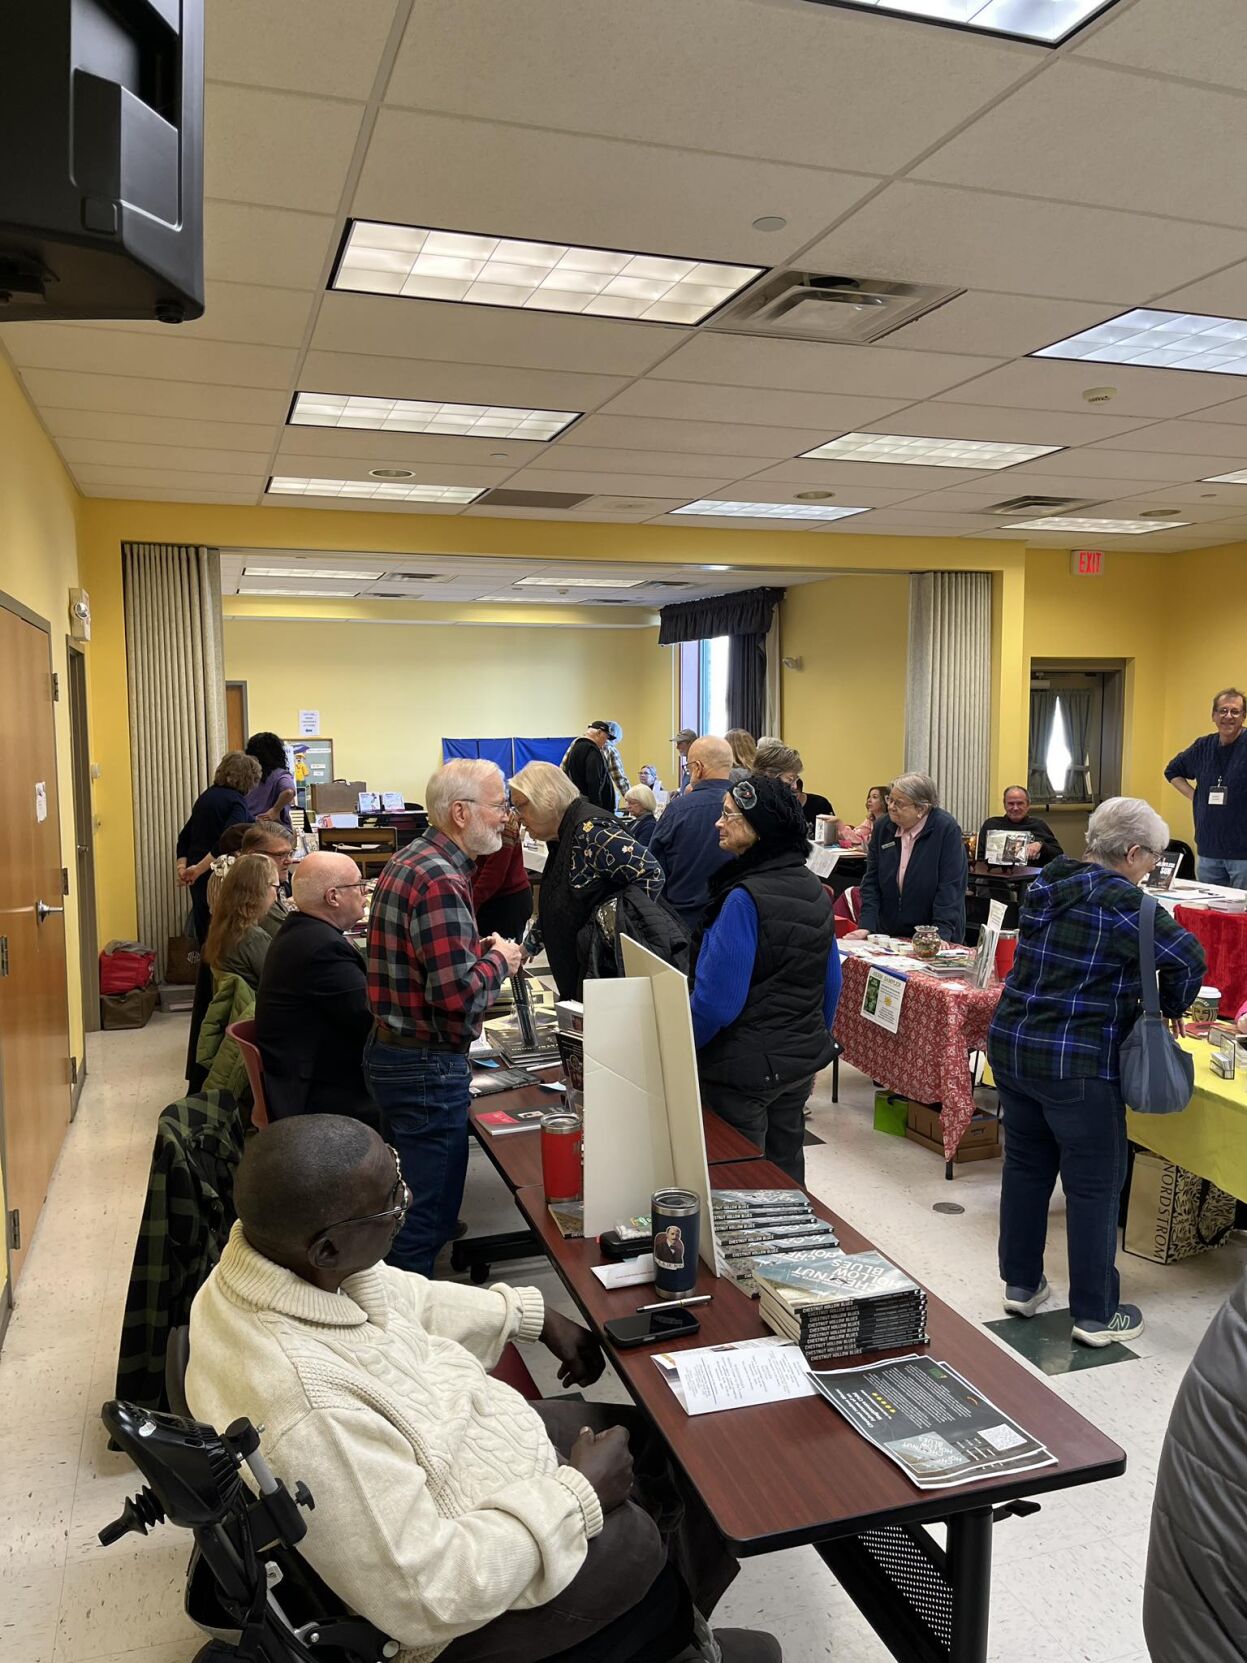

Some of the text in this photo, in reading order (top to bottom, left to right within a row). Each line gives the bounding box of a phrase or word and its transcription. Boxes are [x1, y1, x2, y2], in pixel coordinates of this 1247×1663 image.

[1079, 551, 1102, 575] EXIT
[1153, 1162, 1175, 1260] NORDSTROM
[831, 1258, 884, 1276] BLUES
